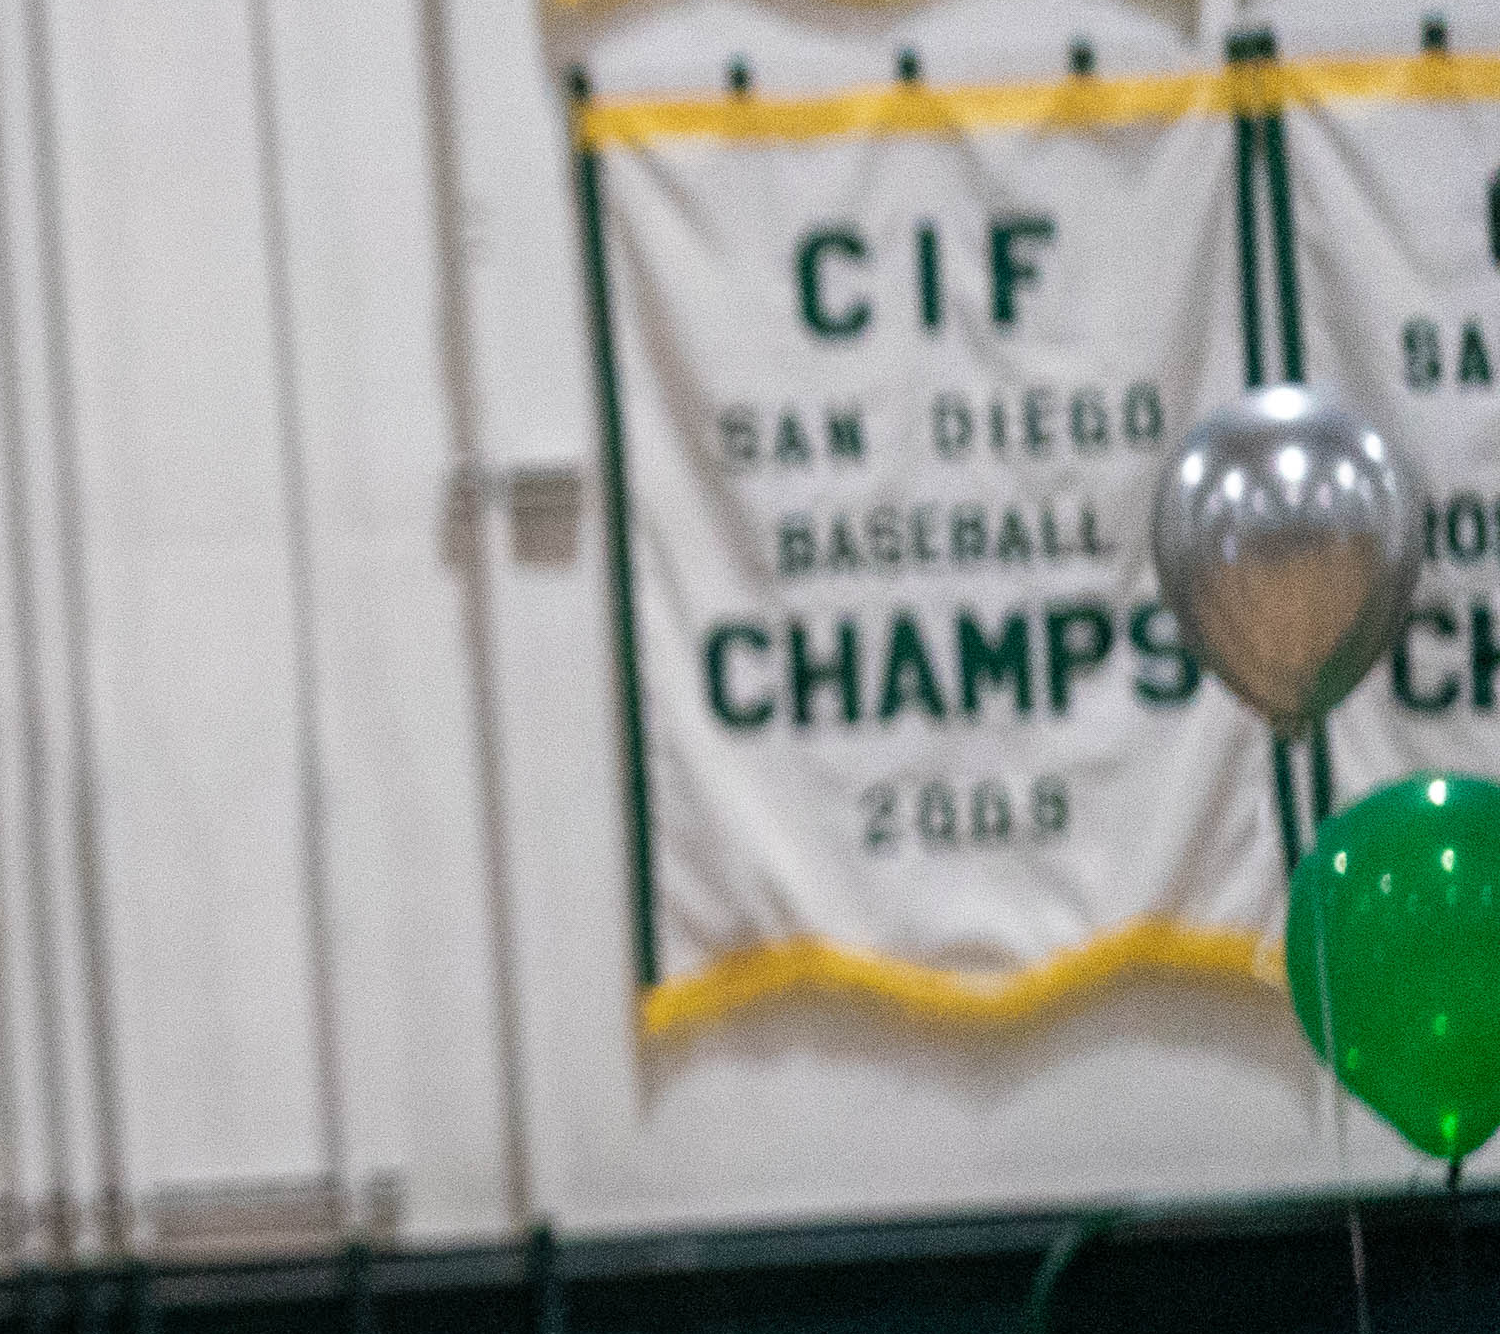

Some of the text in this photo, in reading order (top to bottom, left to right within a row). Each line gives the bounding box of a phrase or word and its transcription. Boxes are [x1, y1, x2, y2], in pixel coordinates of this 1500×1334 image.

[790, 215, 1058, 341] CIF
[712, 381, 1168, 465] SAN DIEGO
[776, 505, 1110, 581] BASEBALL
[700, 597, 1204, 735] CHAMPS
